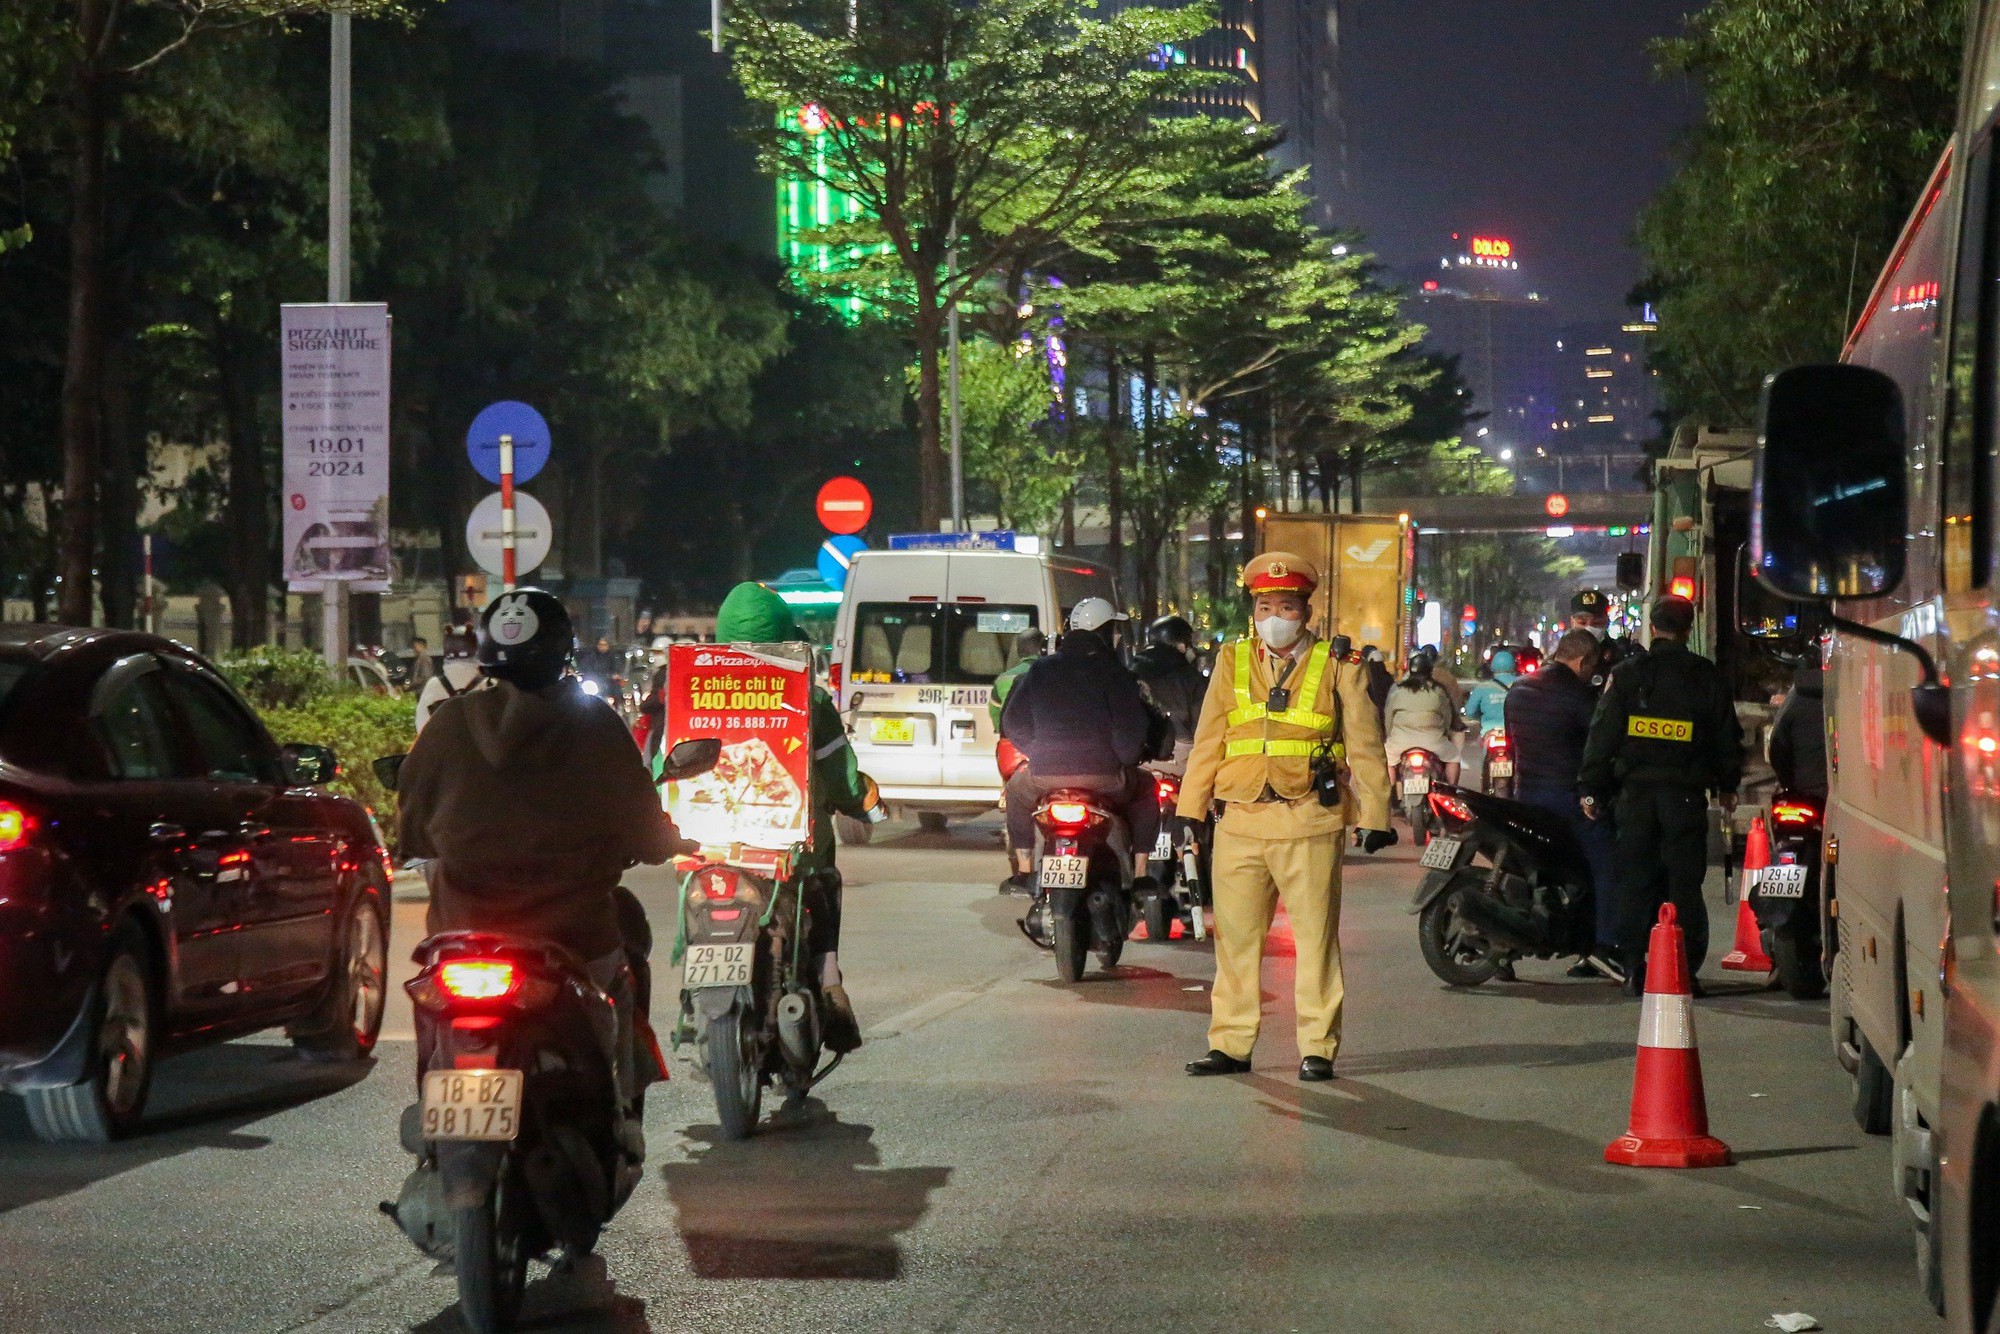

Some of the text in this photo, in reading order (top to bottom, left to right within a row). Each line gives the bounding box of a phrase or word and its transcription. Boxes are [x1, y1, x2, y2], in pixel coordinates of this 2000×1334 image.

[288, 340, 380, 351] SIGNATURE
[308, 438, 364, 453] 19.01
[309, 461, 364, 477] 2024
[691, 676, 700, 690] 2
[704, 674, 741, 690] chiếc
[771, 676, 786, 690] từ
[689, 716, 788, 729] (024) 36.888.777
[1048, 858, 1081, 872] 29-E2
[1043, 872, 1083, 886] 978.32
[1768, 868, 1801, 881] 29-L5
[1761, 882, 1801, 895] 560.84
[695, 946, 744, 963] 29-D2
[687, 965, 747, 983] 271.26
[440, 1076, 506, 1104] 18-B2
[426, 1106, 513, 1135] 981.75
